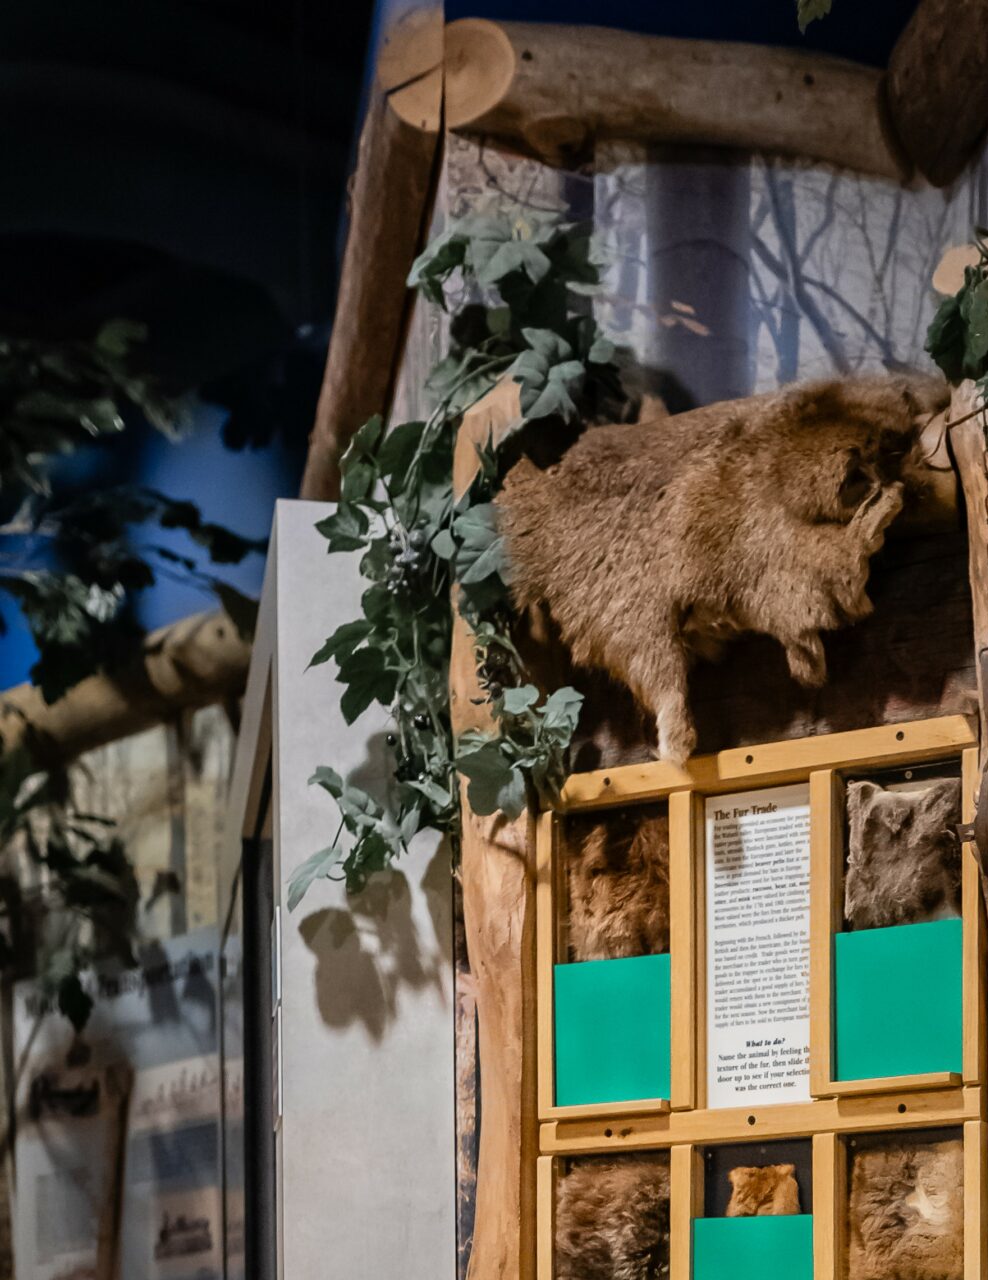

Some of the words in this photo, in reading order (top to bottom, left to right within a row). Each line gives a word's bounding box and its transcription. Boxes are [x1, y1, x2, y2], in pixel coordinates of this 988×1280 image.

[714, 810, 730, 820] The
[734, 808, 748, 818] Fur
[751, 803, 777, 814] Trade
[749, 1050, 769, 1058] animal
[772, 1049, 778, 1057] by
[780, 1047, 802, 1055] feeling
[770, 1072, 784, 1080] your
[759, 1082, 781, 1090] correct
